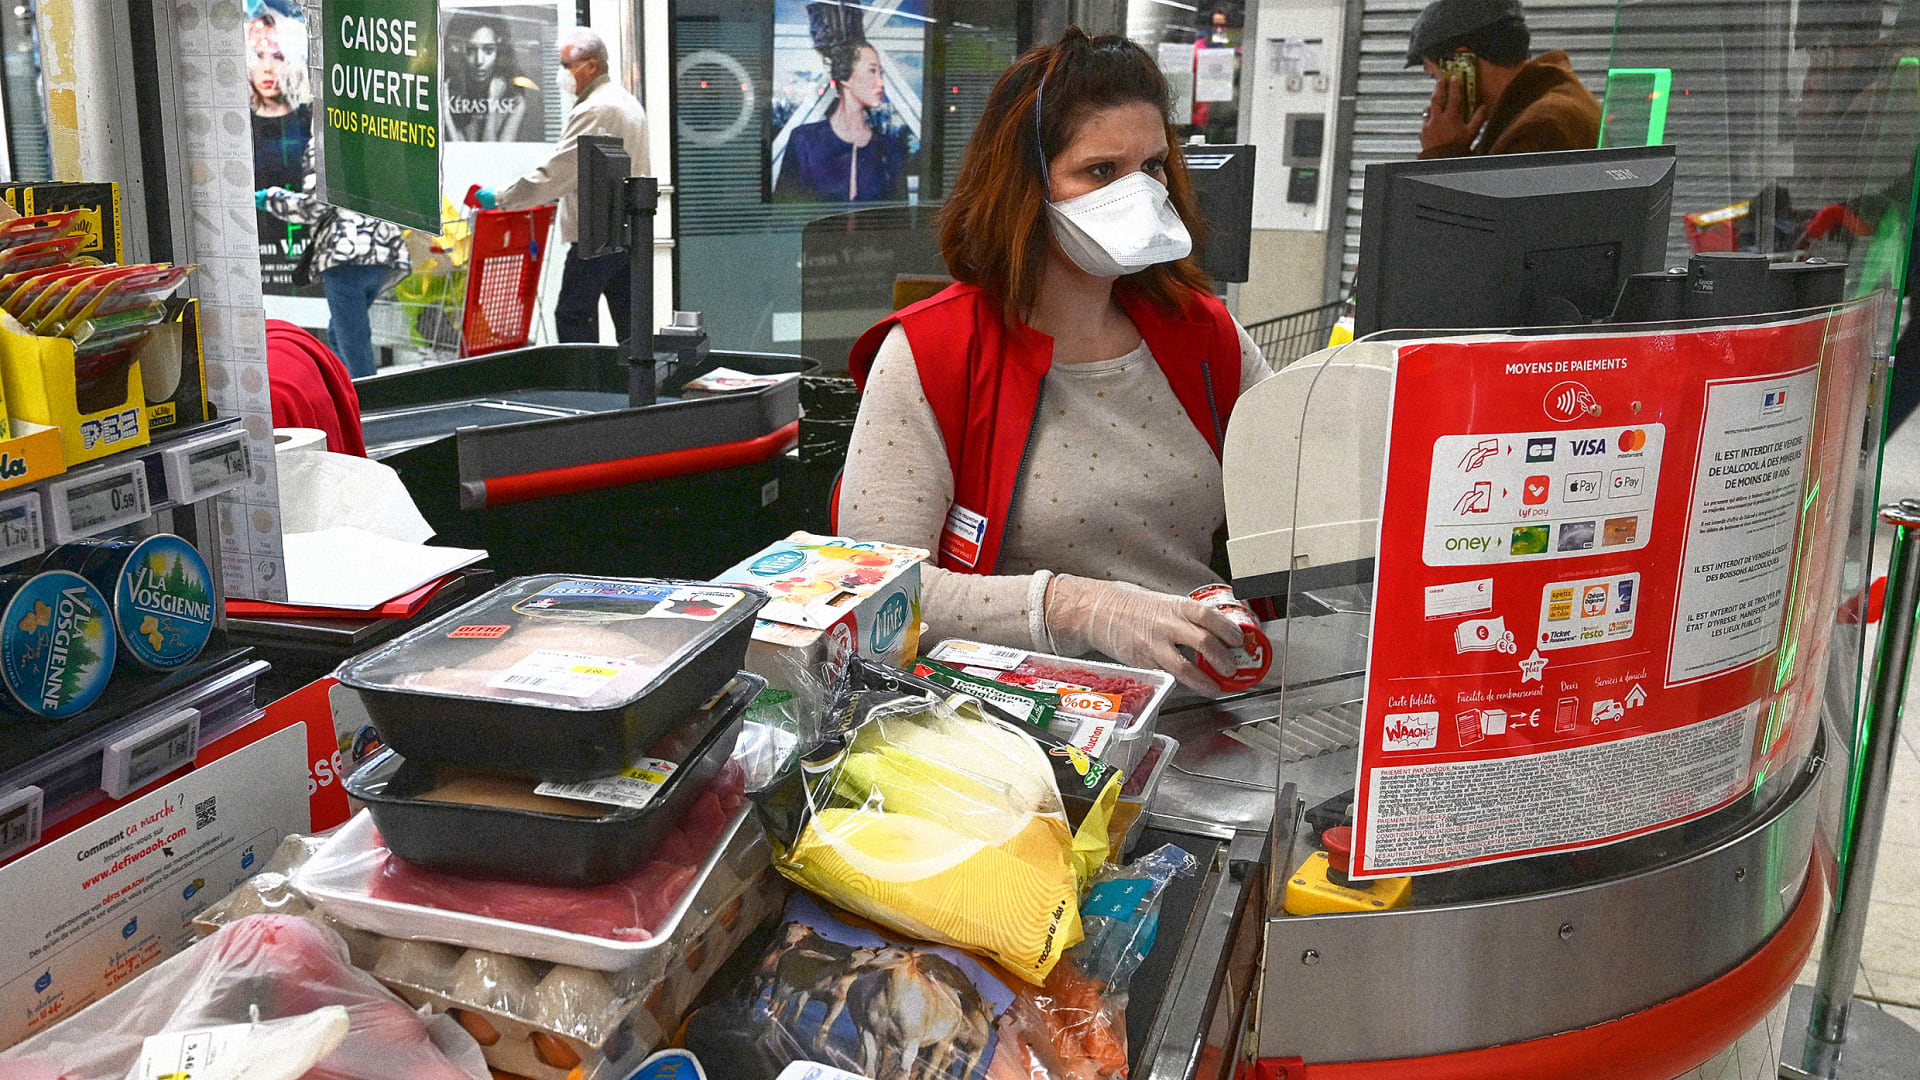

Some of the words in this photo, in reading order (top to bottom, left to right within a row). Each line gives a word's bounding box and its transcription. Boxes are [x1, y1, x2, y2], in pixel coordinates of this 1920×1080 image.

[341, 15, 417, 57] CAISSE
[331, 63, 429, 111] OUVERTE
[327, 107, 358, 132] TOUS
[361, 113, 436, 148] PAIEMENTS
[1505, 362, 1553, 374] MOYENS
[1555, 361, 1568, 372] DE
[1570, 358, 1627, 371] PAIEMENTS
[80, 409, 139, 450] PEZ
[1569, 438, 1606, 456] VISA
[1714, 452, 1722, 462] IL
[1724, 450, 1740, 460] EST
[1741, 444, 1774, 458] INTERDIT
[1775, 441, 1783, 451] DE
[1708, 467, 1721, 477] DE
[1723, 461, 1759, 475] L'ALCOOL
[1767, 456, 1779, 467] DES
[1614, 477, 1622, 488] G
[1624, 476, 1639, 489] Pay
[1725, 480, 1737, 489] DE
[1737, 475, 1762, 487] MOINS
[1762, 472, 1772, 482] DE
[1779, 467, 1790, 478] ANS
[1580, 480, 1597, 494] Pay
[1518, 508, 1531, 518] lyf
[1532, 508, 1549, 518] pay
[1445, 536, 1491, 552] oney
[1694, 566, 1701, 574] IL
[1702, 564, 1714, 572] EST
[1715, 558, 1744, 570] INTERDIT
[1744, 556, 1751, 564] DE
[148, 569, 167, 592] LA
[1706, 574, 1719, 582] DES
[1720, 568, 1747, 580] BOISSONS
[126, 567, 211, 622] VOSGIENNE
[1686, 622, 1704, 632] ÉTAT
[1739, 604, 1767, 619] MANIFESTE
[1696, 611, 1708, 620] EST
[1709, 605, 1738, 617] INTERDIT
[1739, 602, 1747, 610] DE
[71, 613, 91, 639] LA
[1550, 630, 1571, 639] Ticket
[1580, 629, 1603, 640] resto
[1712, 628, 1722, 637] LES
[1723, 624, 1740, 635] LIEUX
[42, 586, 92, 711] VOSGIENNE
[1595, 677, 1618, 688] Services
[1625, 667, 1647, 683] domicile
[1486, 689, 1495, 701] de
[1496, 685, 1544, 700] remboursement
[1561, 681, 1578, 692] Devis
[1064, 696, 1112, 711] -30%
[1388, 695, 1407, 708] Carte
[1409, 693, 1437, 708] fidélité
[1529, 708, 1542, 727] €
[77, 831, 124, 862] Comment
[126, 824, 137, 837] ça
[140, 799, 175, 828] marche
[178, 793, 184, 808] ?
[1377, 816, 1407, 824] PAIEMENT
[153, 826, 164, 835] sur
[1376, 830, 1413, 839] CONDITIONS
[1455, 824, 1467, 832] DES
[1387, 850, 1410, 858] AUTRES
[1412, 847, 1437, 856] MOYENS
[102, 891, 120, 906] DÉFIS
